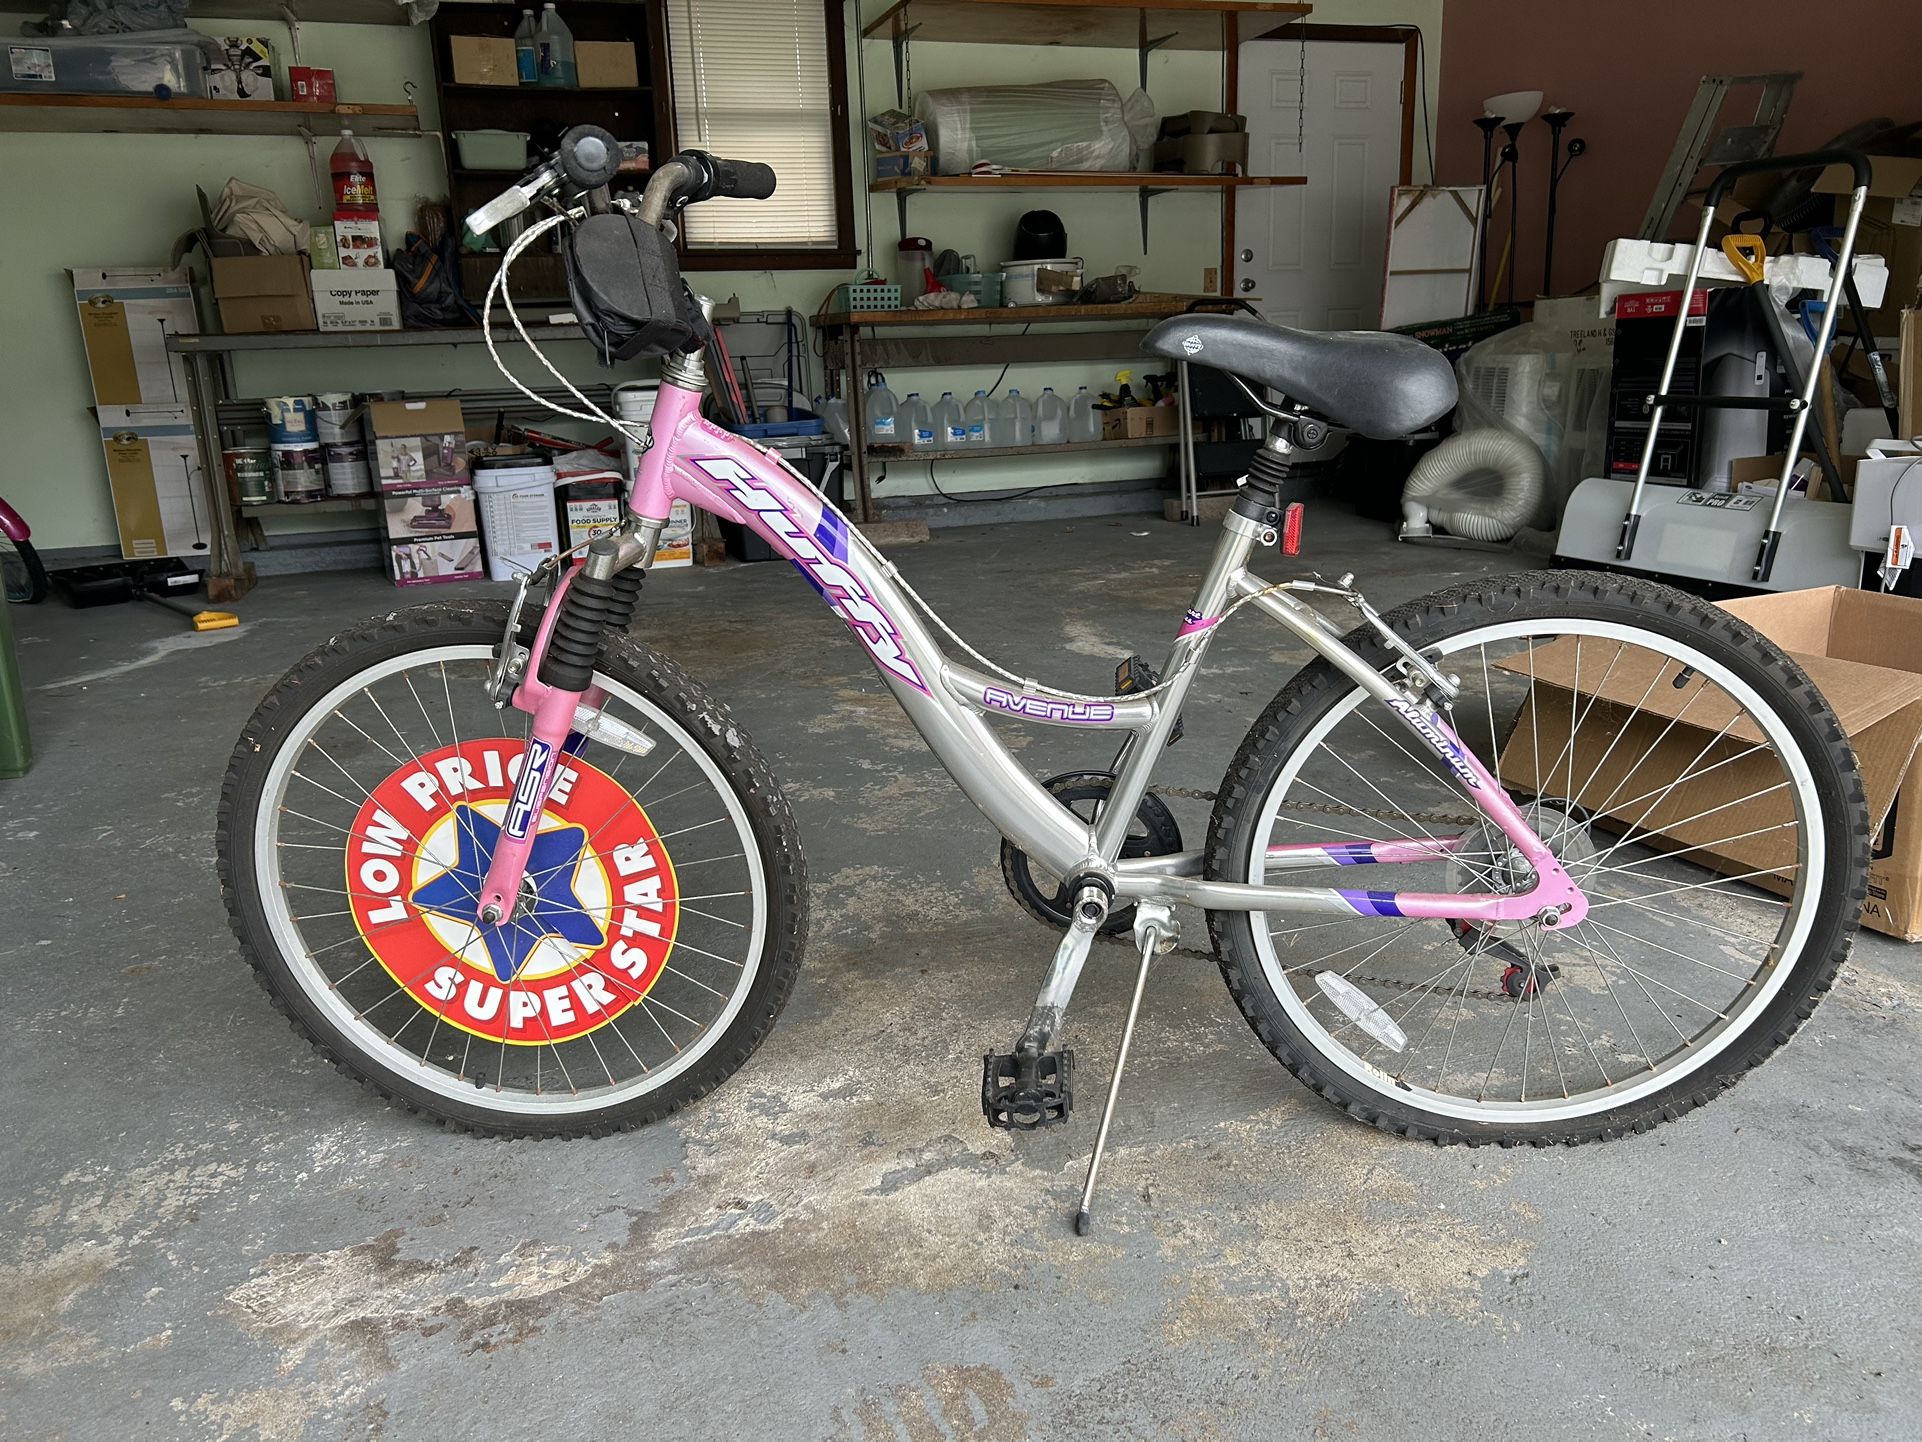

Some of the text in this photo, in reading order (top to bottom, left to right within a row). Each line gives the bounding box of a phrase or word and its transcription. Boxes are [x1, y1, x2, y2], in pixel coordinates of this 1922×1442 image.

[344, 184, 373, 195] IceMelt
[330, 290, 380, 298] Copy Paper
[1415, 327, 1453, 339] SNOWMAN
[1706, 498, 1726, 506] PRO
[592, 516, 618, 524] SUPPLY
[414, 535, 434, 543] Premium
[985, 688, 1113, 721] AVENUE
[1386, 699, 1480, 789] Aluminum
[360, 809, 411, 924] LOW
[424, 837, 664, 1029] SUPER STAR
